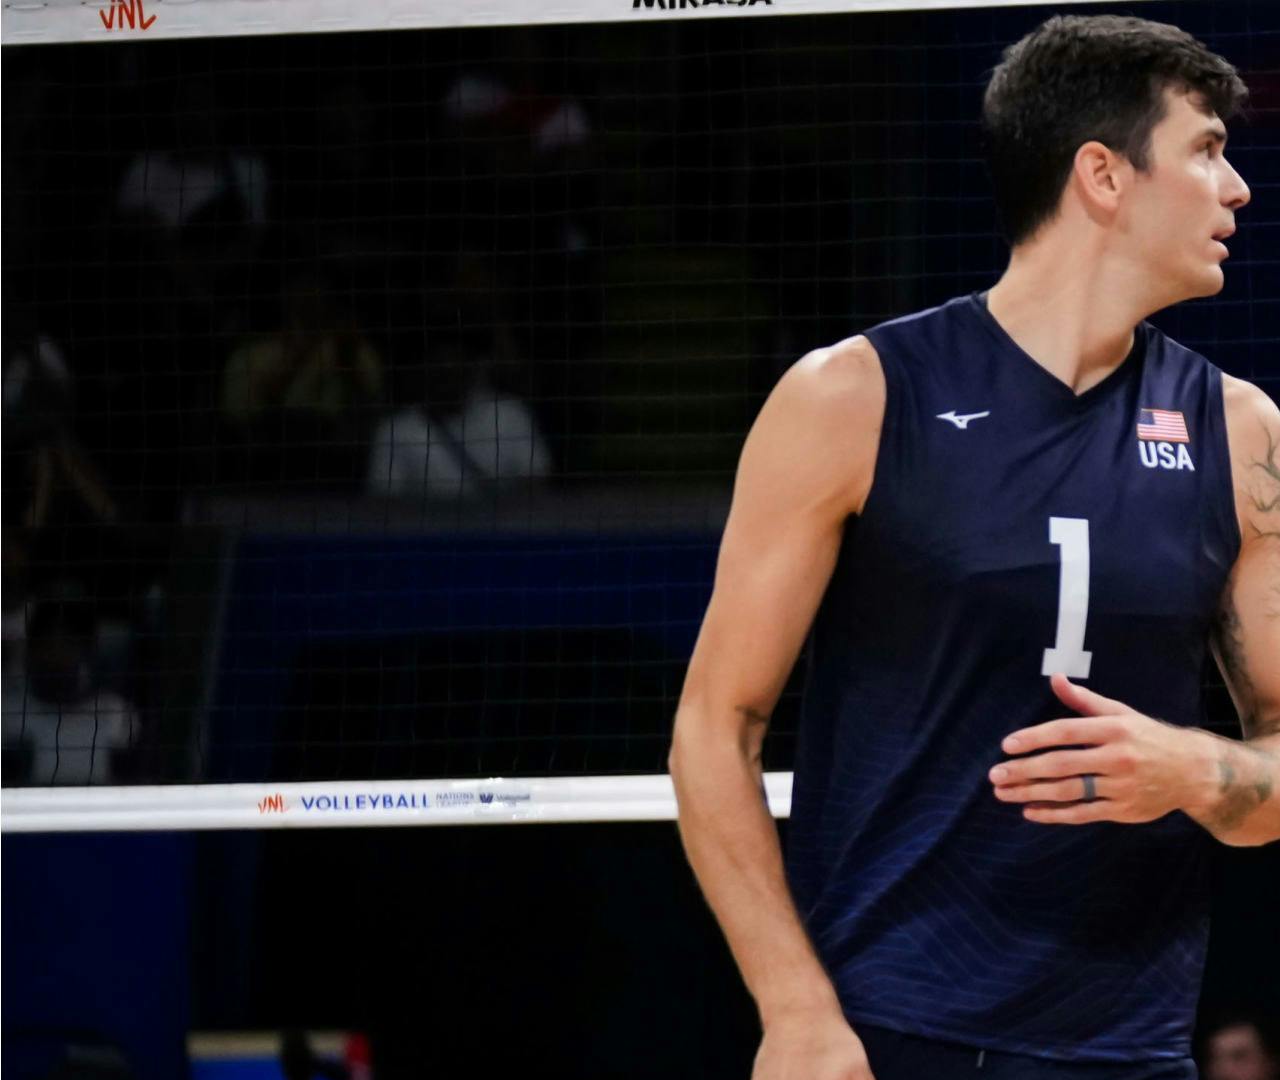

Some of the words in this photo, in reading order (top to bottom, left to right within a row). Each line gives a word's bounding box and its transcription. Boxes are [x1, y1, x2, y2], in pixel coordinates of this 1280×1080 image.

[1138, 441, 1195, 471] USA
[1041, 516, 1092, 679] 1
[301, 793, 429, 811] VOLLEYBALL
